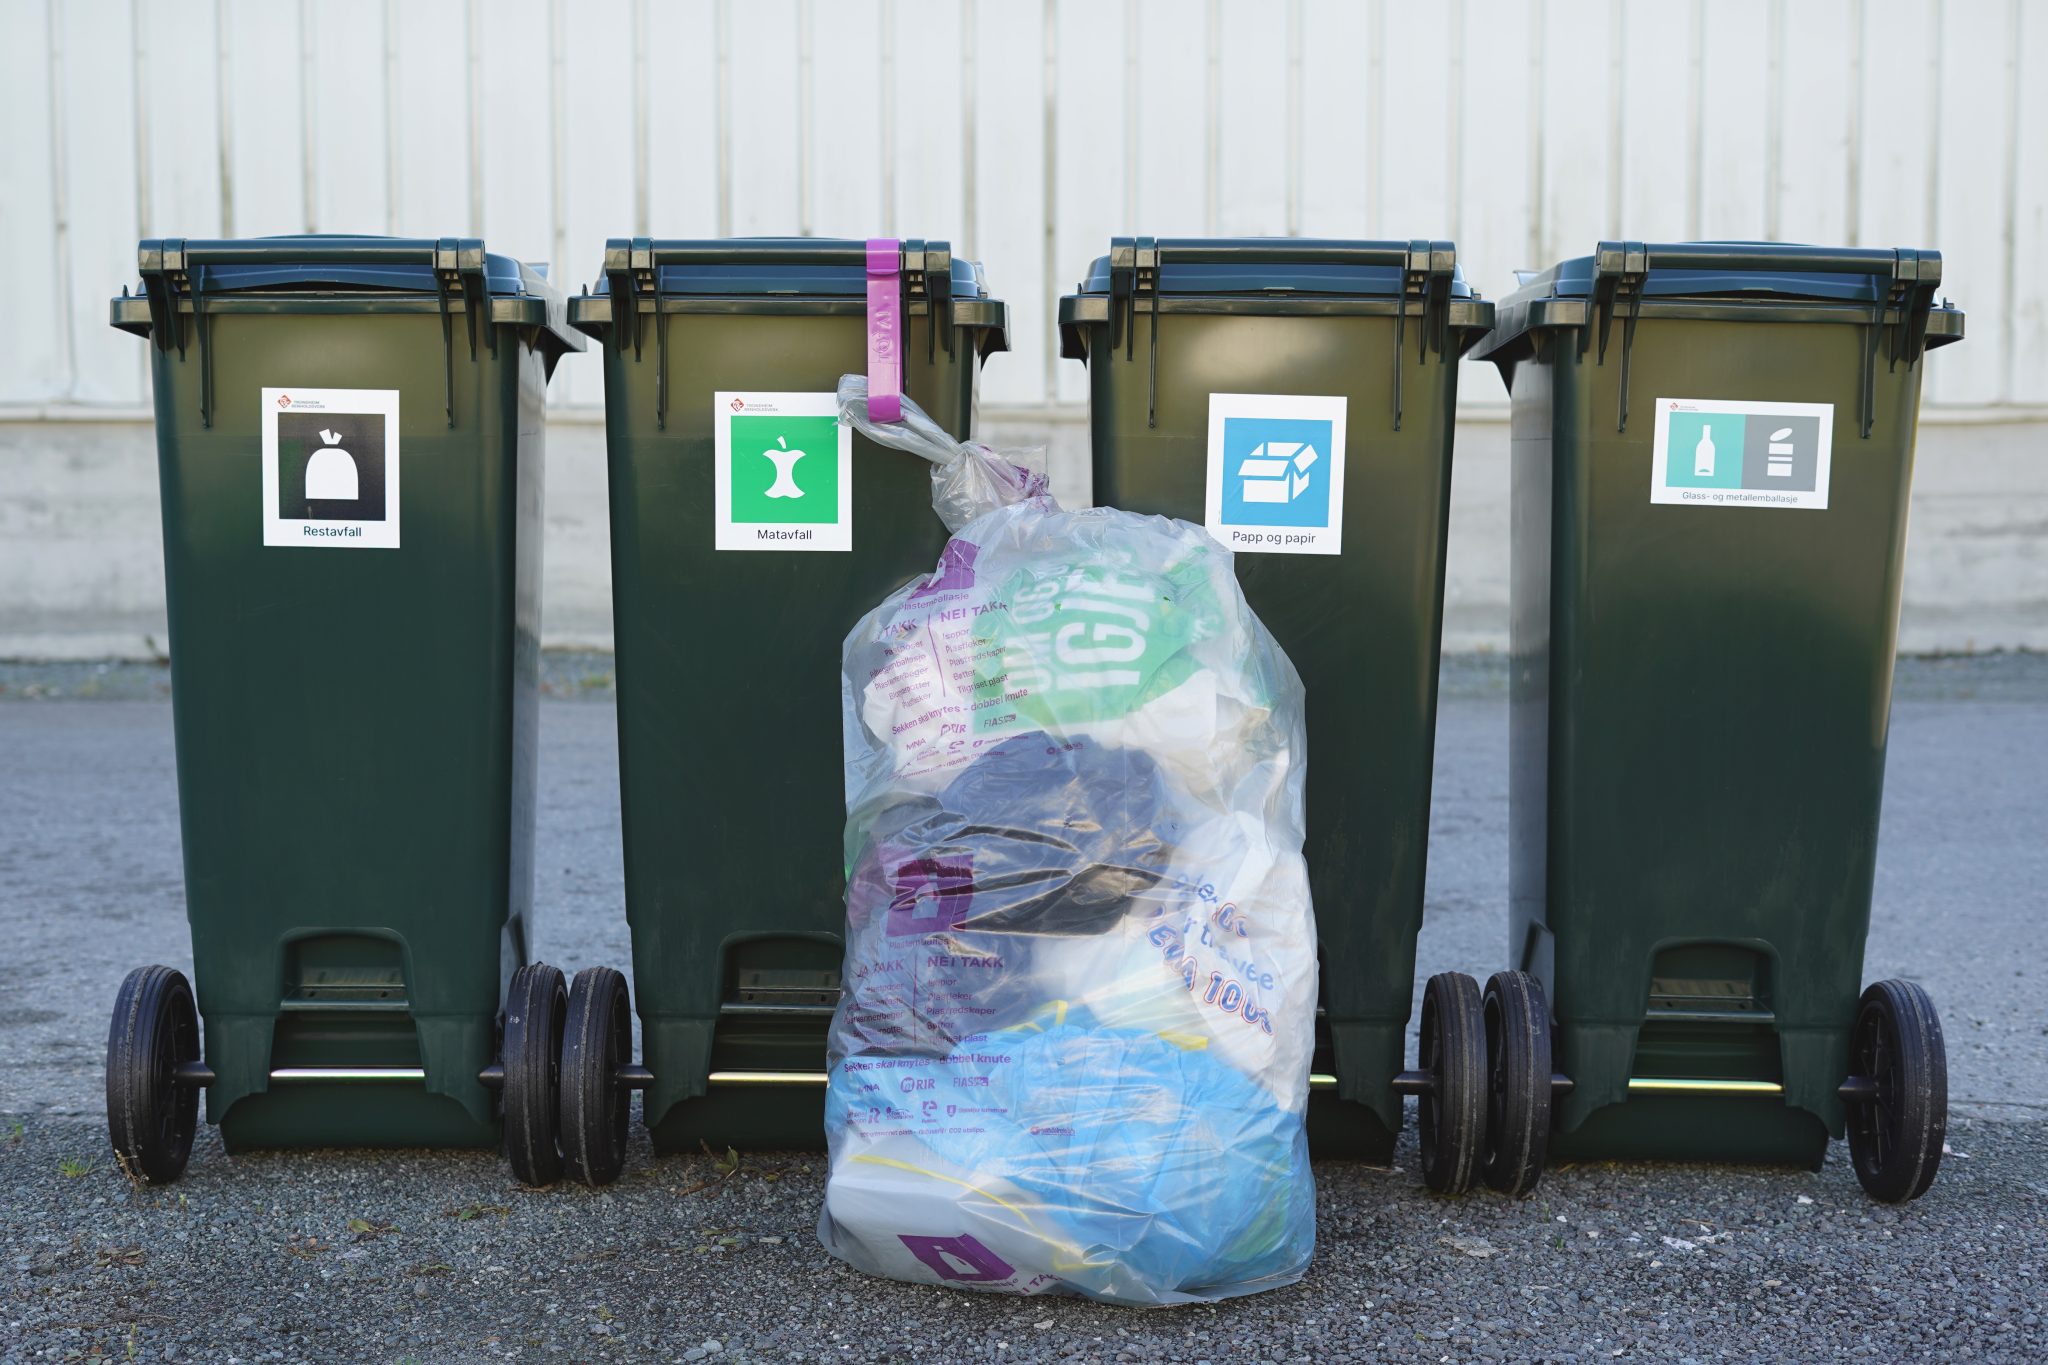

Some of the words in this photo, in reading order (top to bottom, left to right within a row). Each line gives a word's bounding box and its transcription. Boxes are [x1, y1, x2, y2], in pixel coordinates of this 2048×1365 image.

[1682, 491, 1710, 500] Glass-
[1712, 494, 1724, 502] og
[1726, 493, 1798, 504] metallemballasje
[303, 525, 362, 537] Restavfall
[757, 529, 812, 540] Matavfall
[1232, 531, 1263, 544] Papp
[1266, 535, 1282, 545] og
[1285, 533, 1316, 545] papir
[940, 607, 967, 622] NEI
[892, 720, 918, 735] Sekken
[927, 955, 955, 968] NEI
[960, 955, 1004, 968] TAKK
[844, 1062, 874, 1073] Sekken
[875, 1059, 900, 1069] skal
[939, 1053, 974, 1065] dobbel
[976, 1053, 1012, 1064] knute
[916, 1078, 936, 1090] RIR
[1028, 1272, 1064, 1287] TAK
